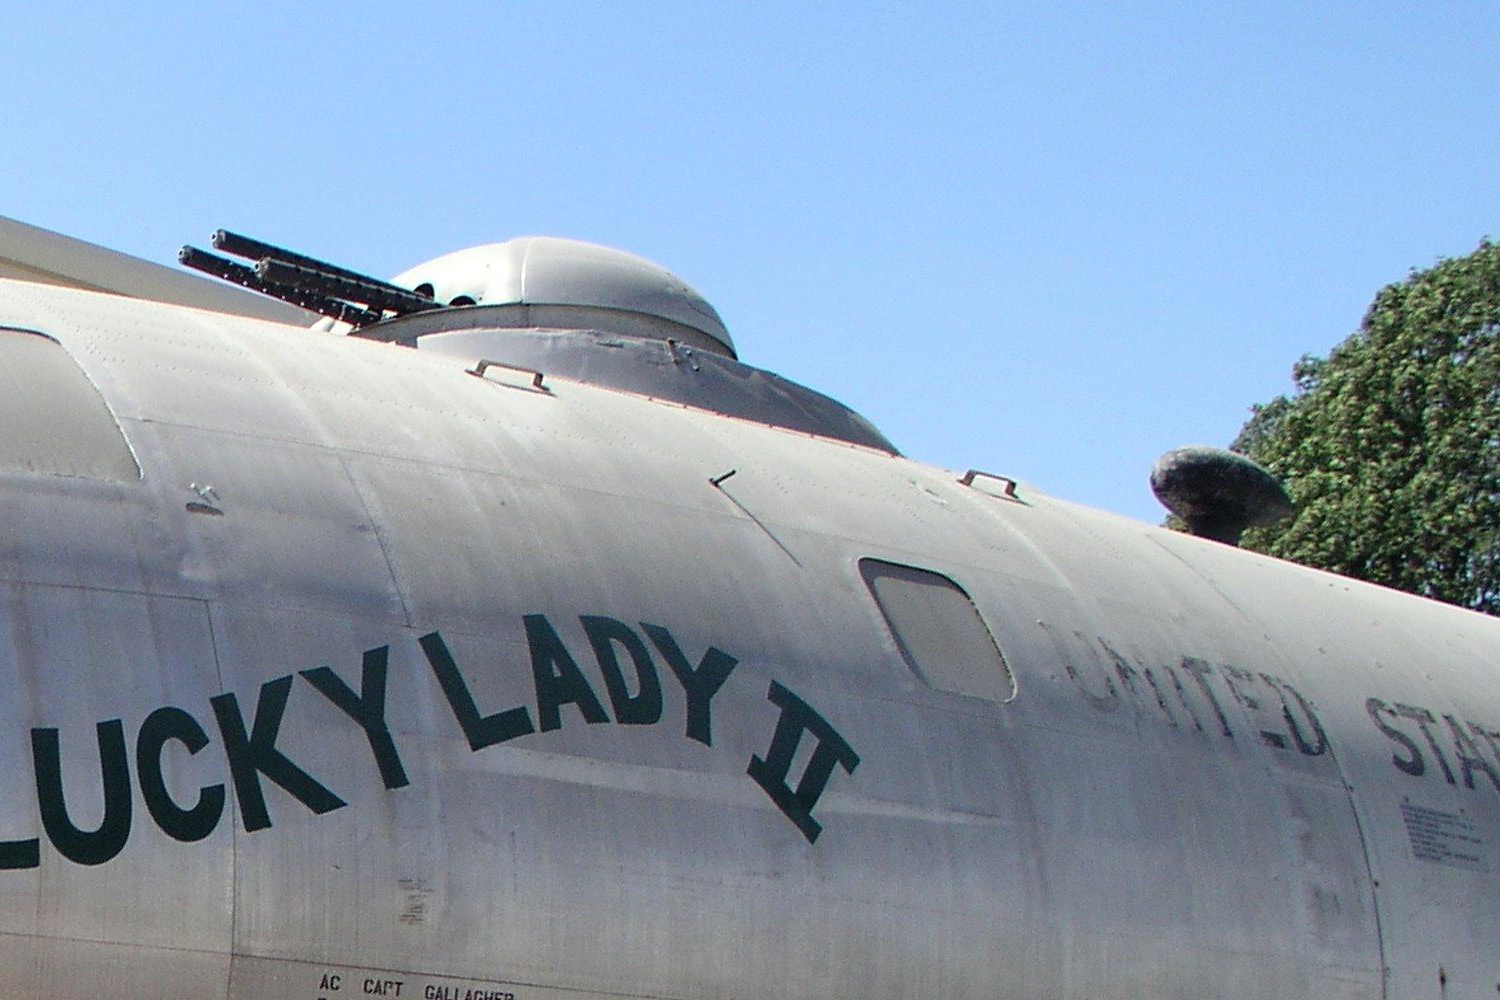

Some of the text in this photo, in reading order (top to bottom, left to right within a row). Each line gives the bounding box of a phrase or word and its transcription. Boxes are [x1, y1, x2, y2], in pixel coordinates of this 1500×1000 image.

[419, 614, 738, 752] LADY
[748, 679, 860, 845] II
[319, 974, 341, 991] AC
[363, 979, 404, 997] CAPT
